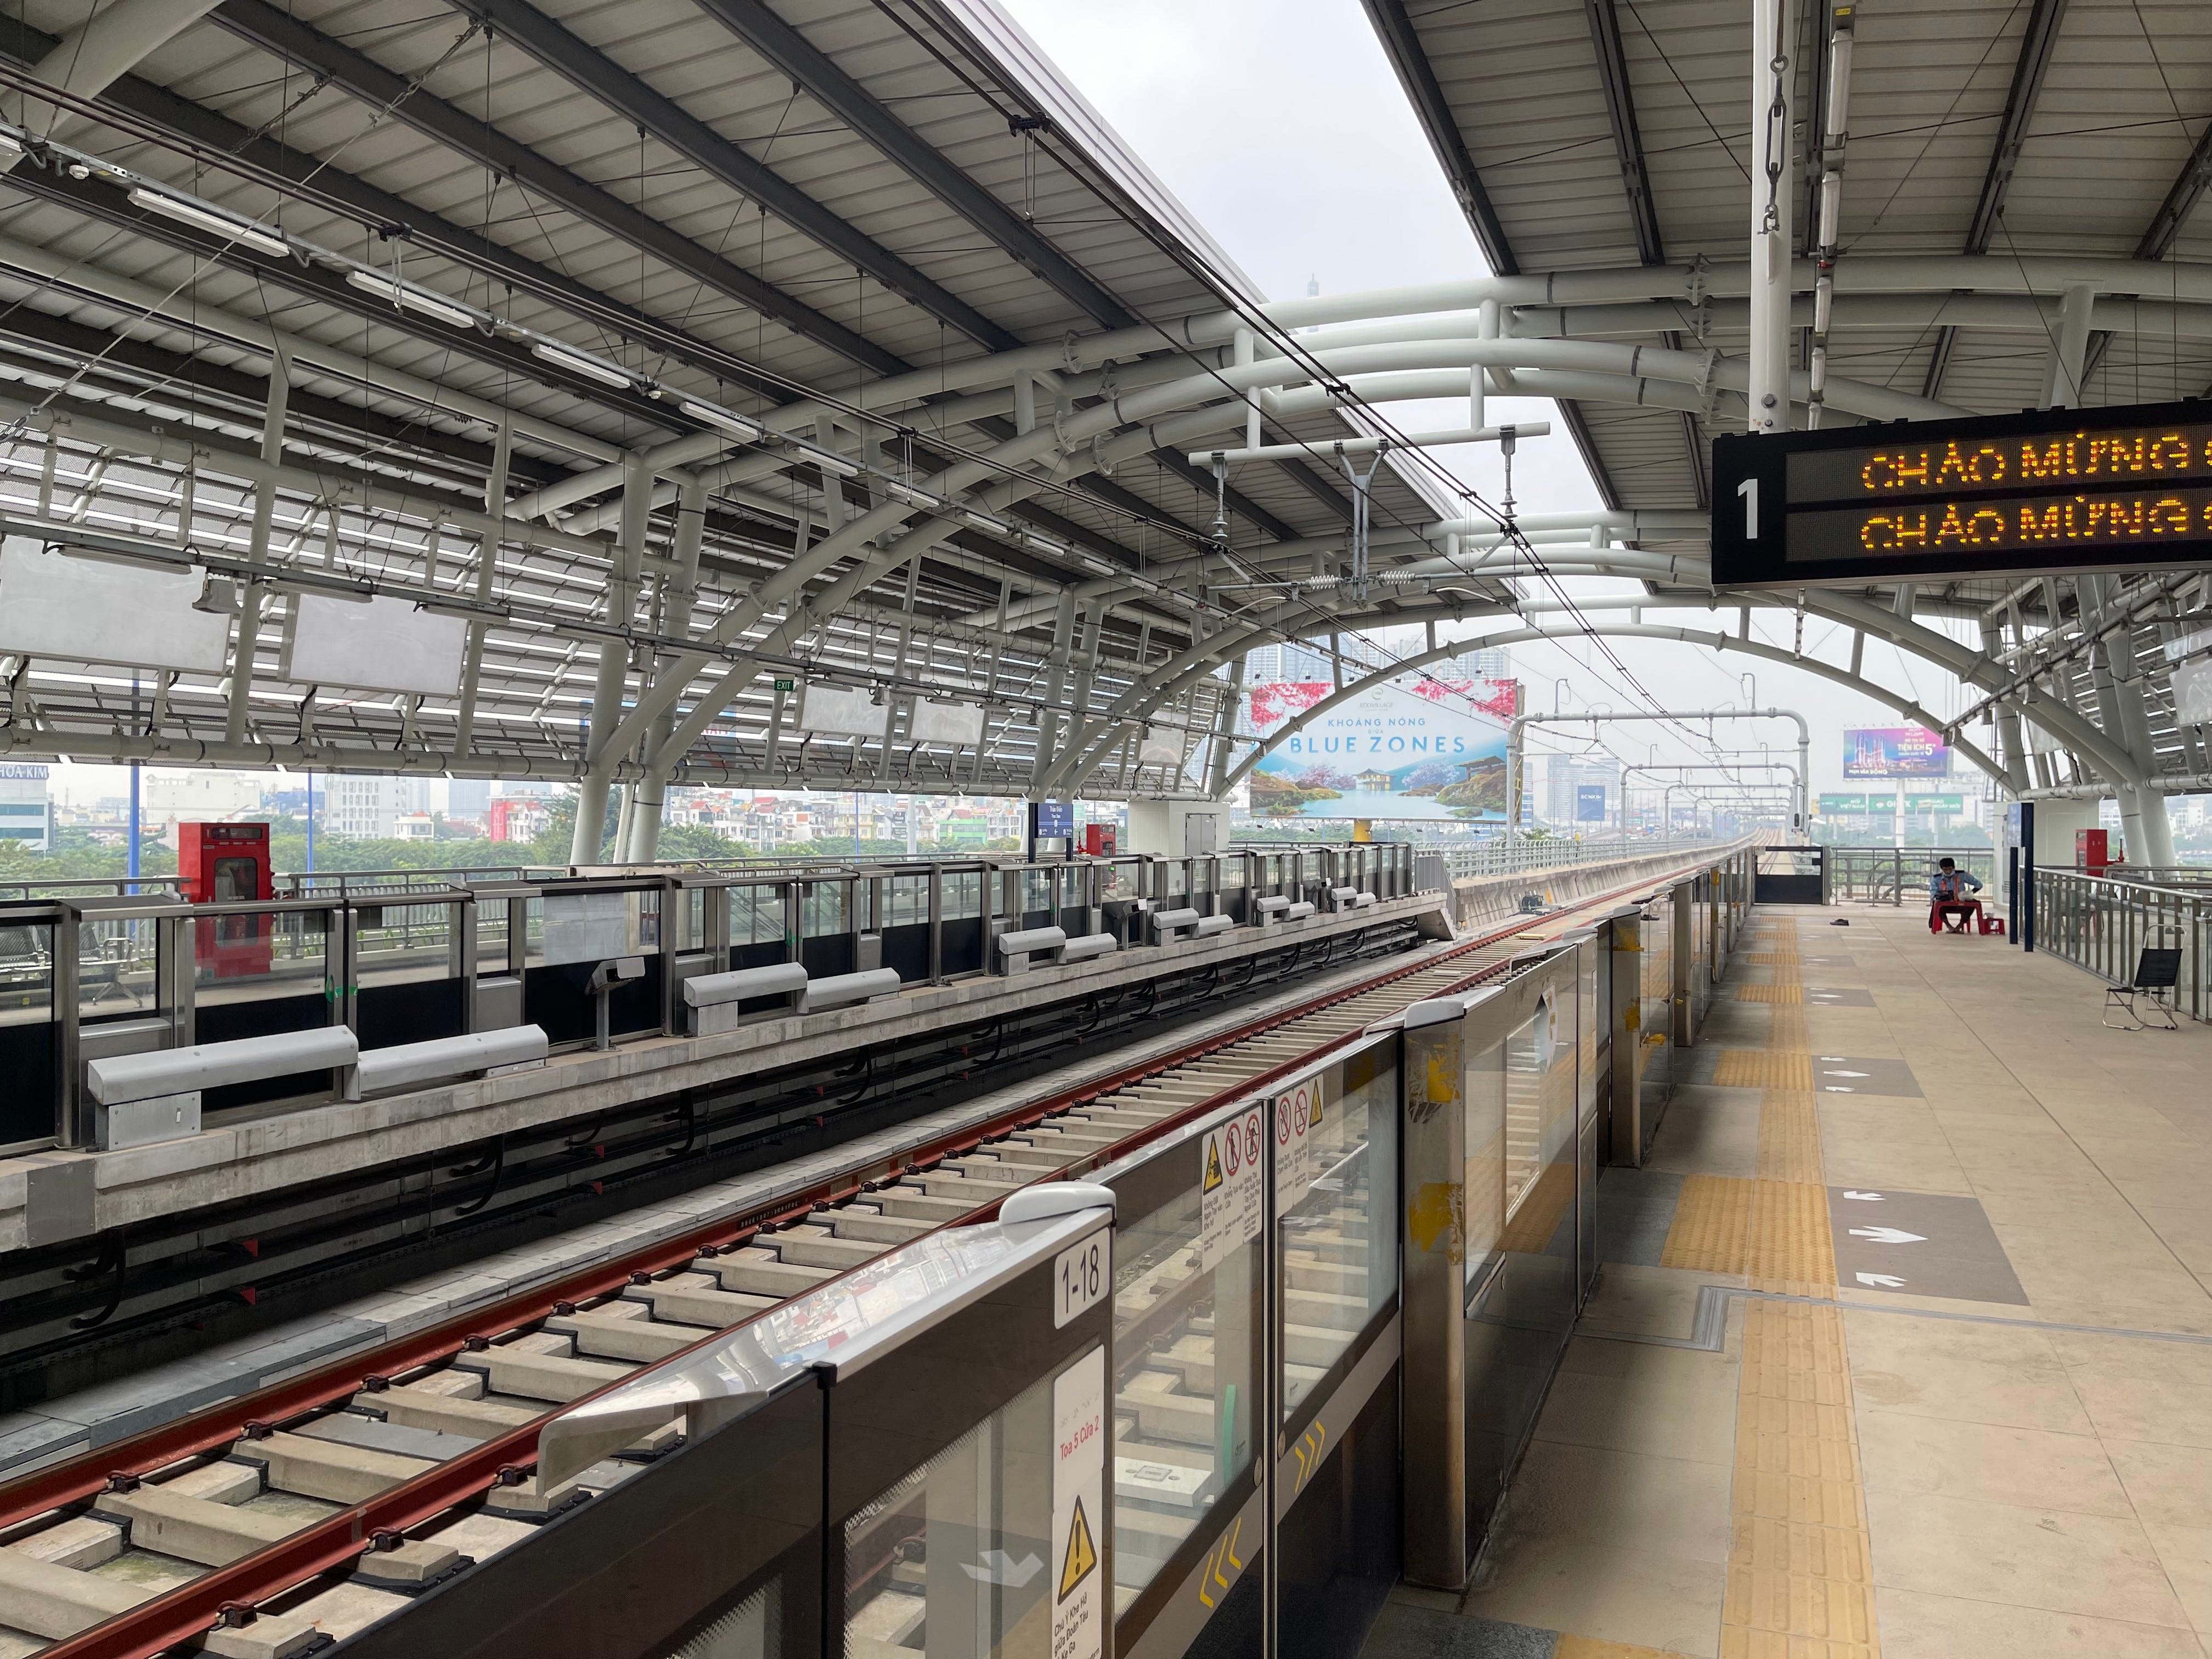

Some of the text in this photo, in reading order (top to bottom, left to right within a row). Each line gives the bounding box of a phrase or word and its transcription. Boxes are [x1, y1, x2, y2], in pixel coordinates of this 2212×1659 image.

[1737, 478, 1759, 539] 1
[777, 681, 791, 690] EXIT
[1290, 736, 1465, 754] BLUE ZONES
[26, 766, 47, 778] KIM
[1062, 1243, 1099, 1314] 1-18
[1060, 1415, 1099, 1461] Toa 5 Cửa 2
[1054, 1618, 1064, 1637] Chú
[1070, 1604, 1079, 1621] Khe
[1054, 1635, 1065, 1657] giữa
[1080, 1610, 1088, 1625] Tàu
[1069, 1641, 1076, 1654] Ga
